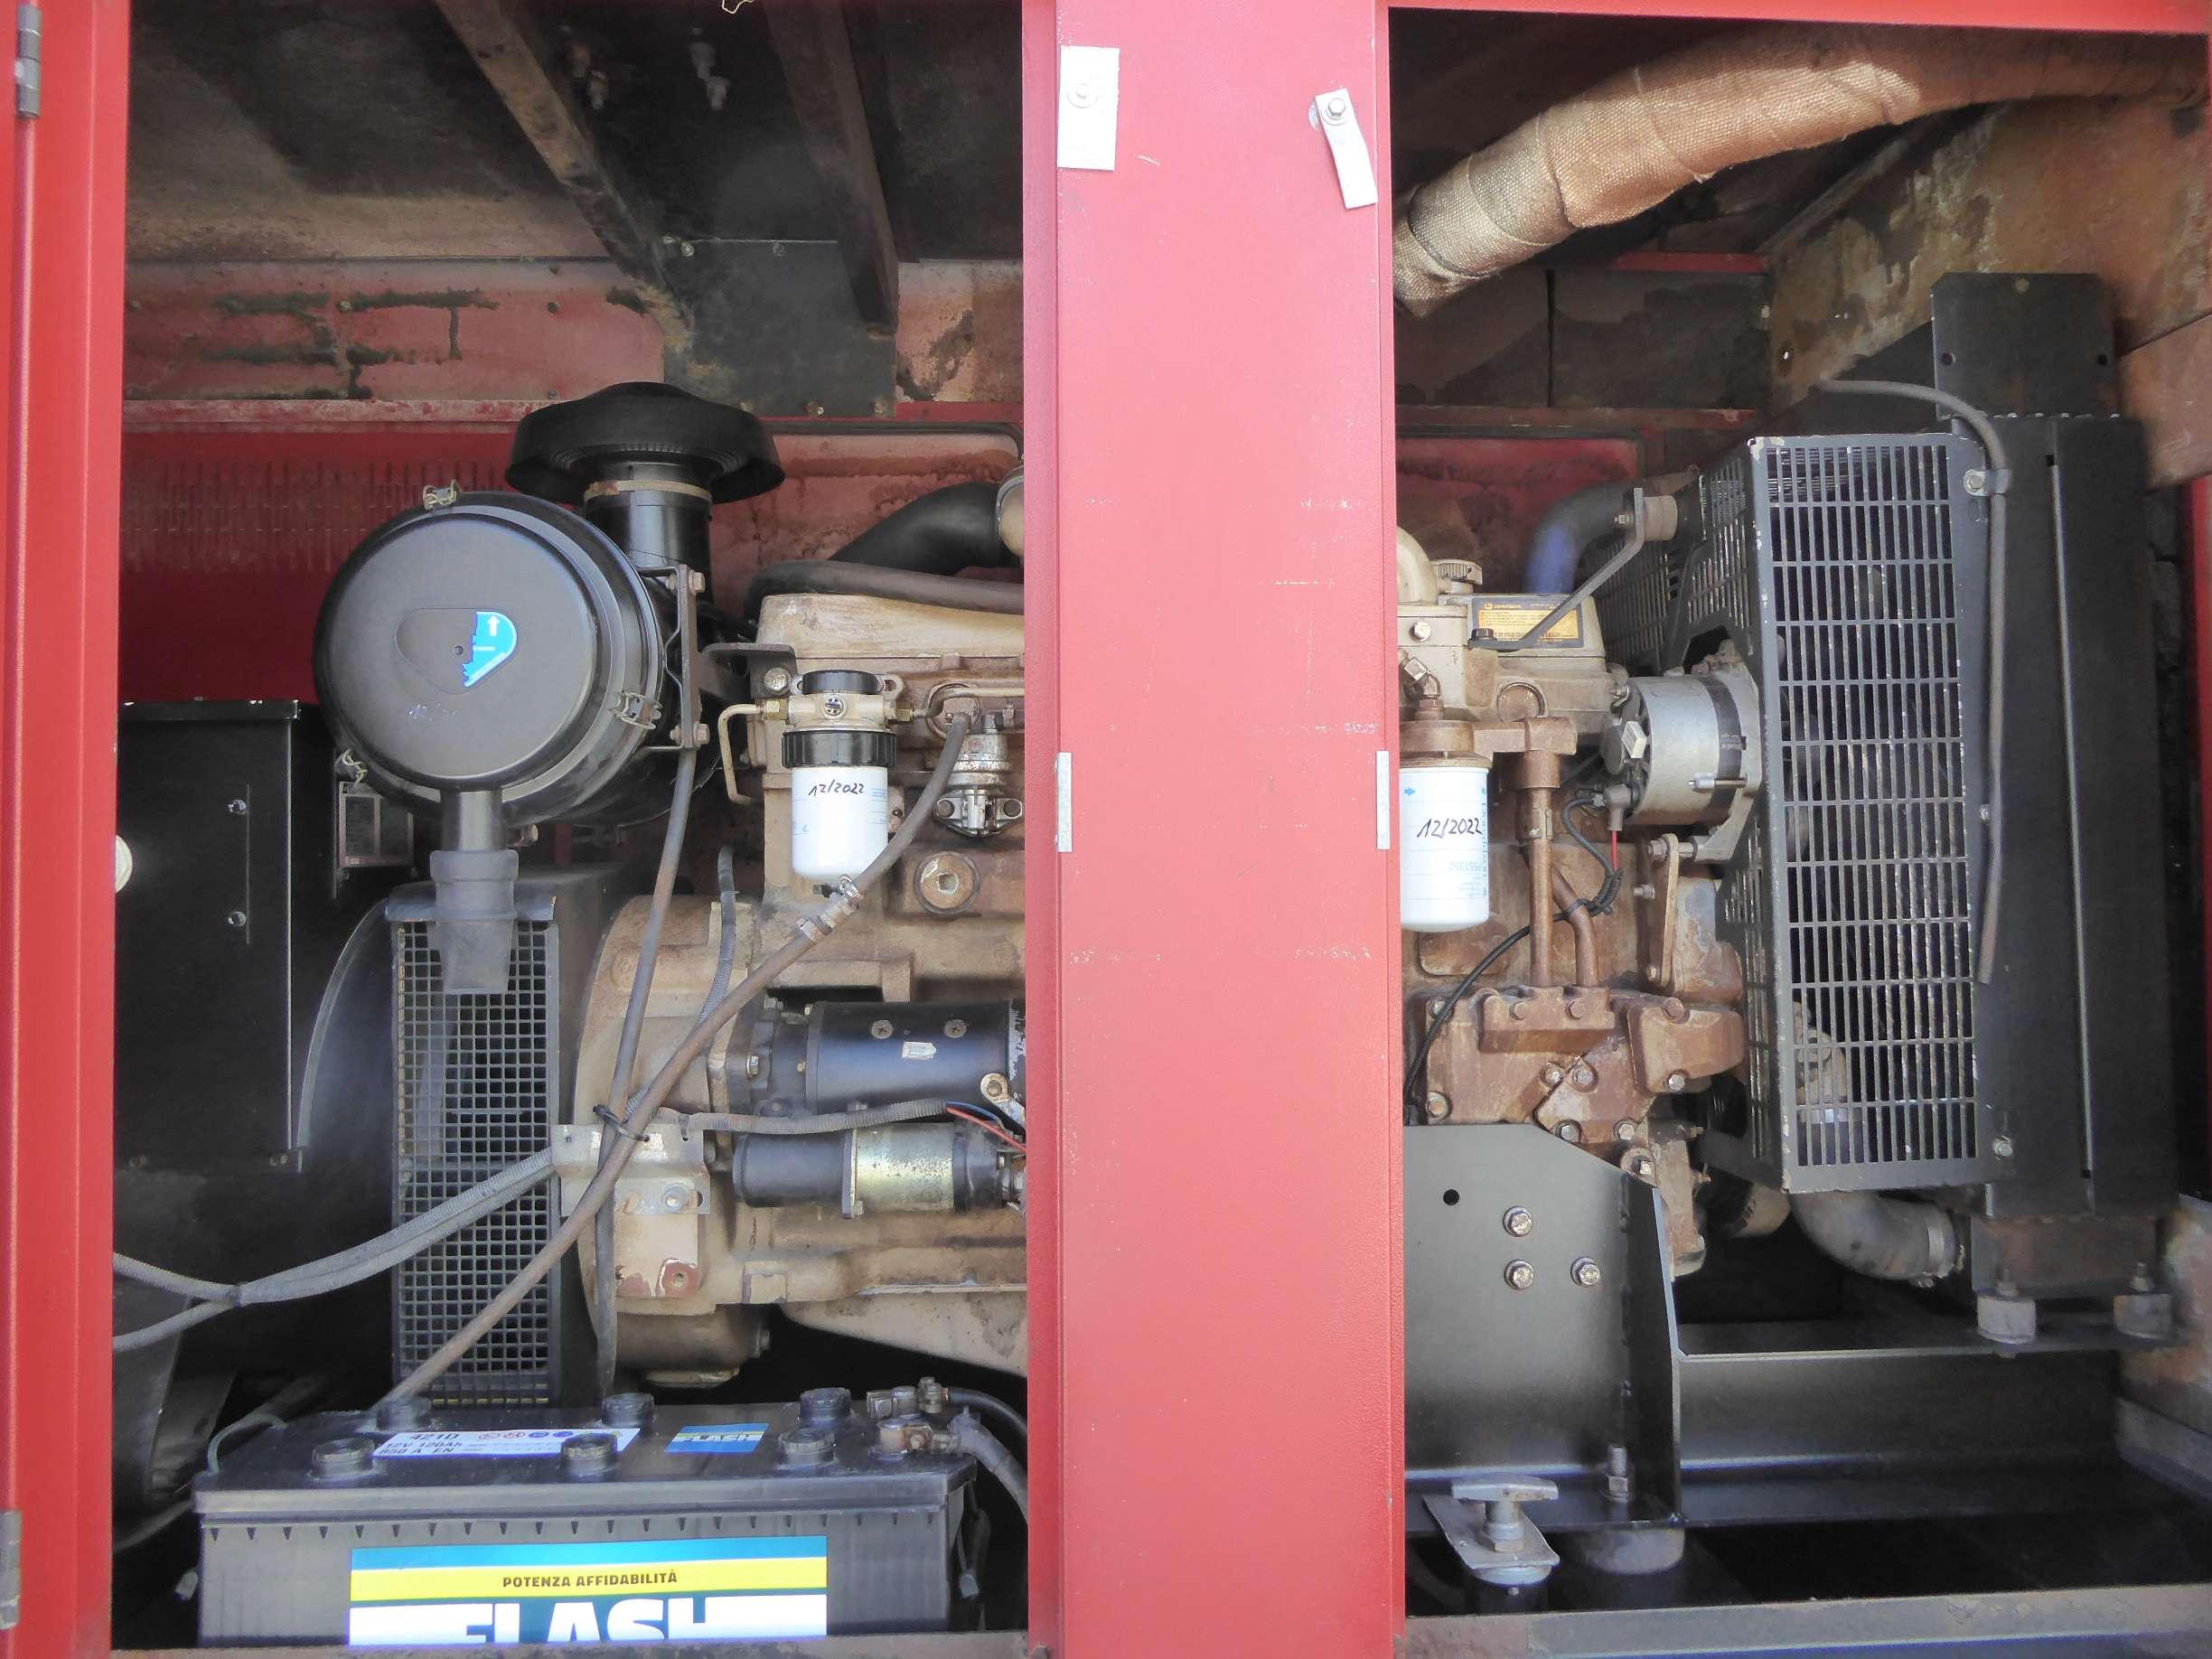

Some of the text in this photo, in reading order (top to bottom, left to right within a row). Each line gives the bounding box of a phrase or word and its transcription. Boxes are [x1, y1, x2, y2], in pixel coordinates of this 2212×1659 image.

[808, 779, 865, 796] 12/2022
[1416, 818, 1483, 839] 12/2022
[502, 1570, 678, 1588] POTENZA AFFIDABILITÀ
